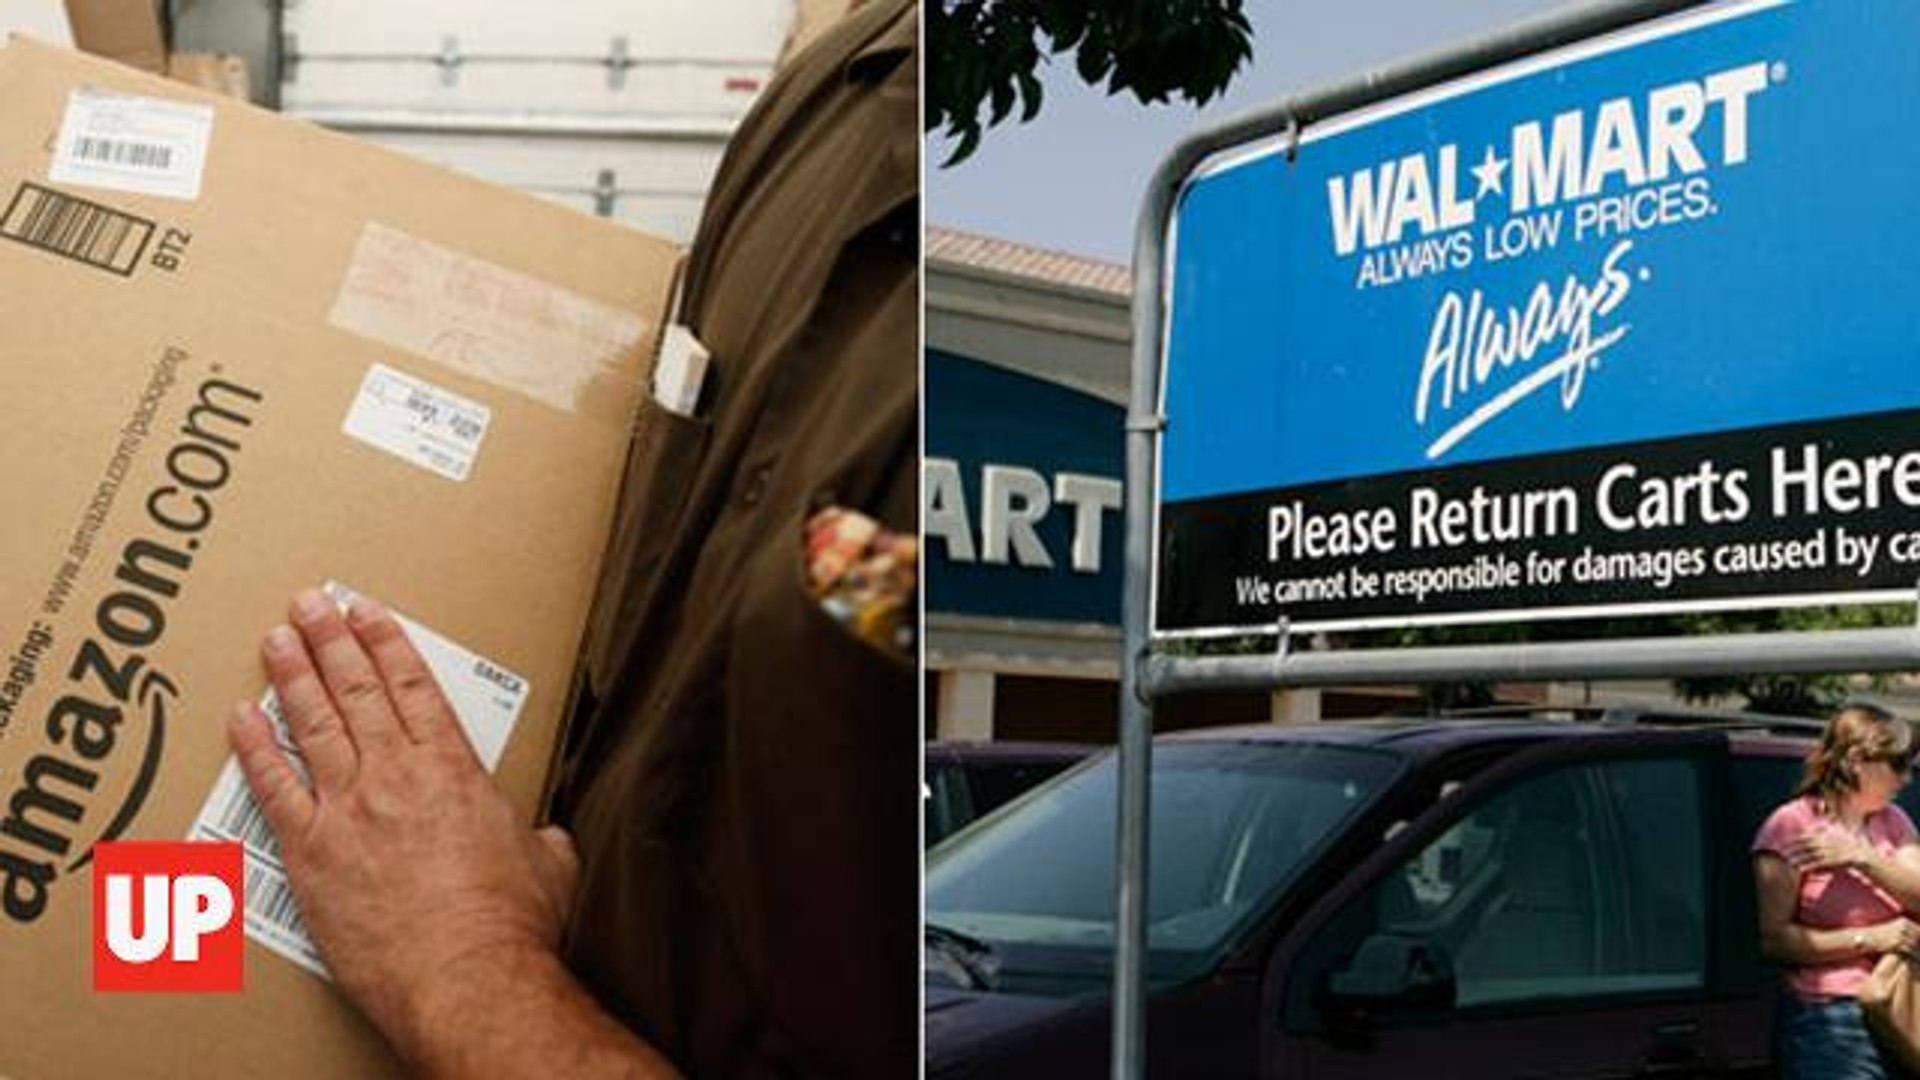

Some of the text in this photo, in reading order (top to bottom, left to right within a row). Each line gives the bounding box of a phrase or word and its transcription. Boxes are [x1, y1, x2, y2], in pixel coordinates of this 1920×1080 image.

[152, 228, 192, 271] BT2
[1356, 179, 1718, 289] ALWAYS LOW PRICES.
[924, 457, 1123, 573] ART
[1268, 444, 1920, 562] Please Return Carts Here
[1236, 577, 1270, 605] We
[1274, 569, 1346, 602] cannot
[1351, 566, 1380, 598] be
[1384, 555, 1519, 602] responsible
[1526, 551, 1565, 584] for
[1572, 545, 1705, 588] damages
[1714, 529, 1825, 573] caused
[1836, 527, 1879, 576] by
[0, 379, 262, 924] amazon.com
